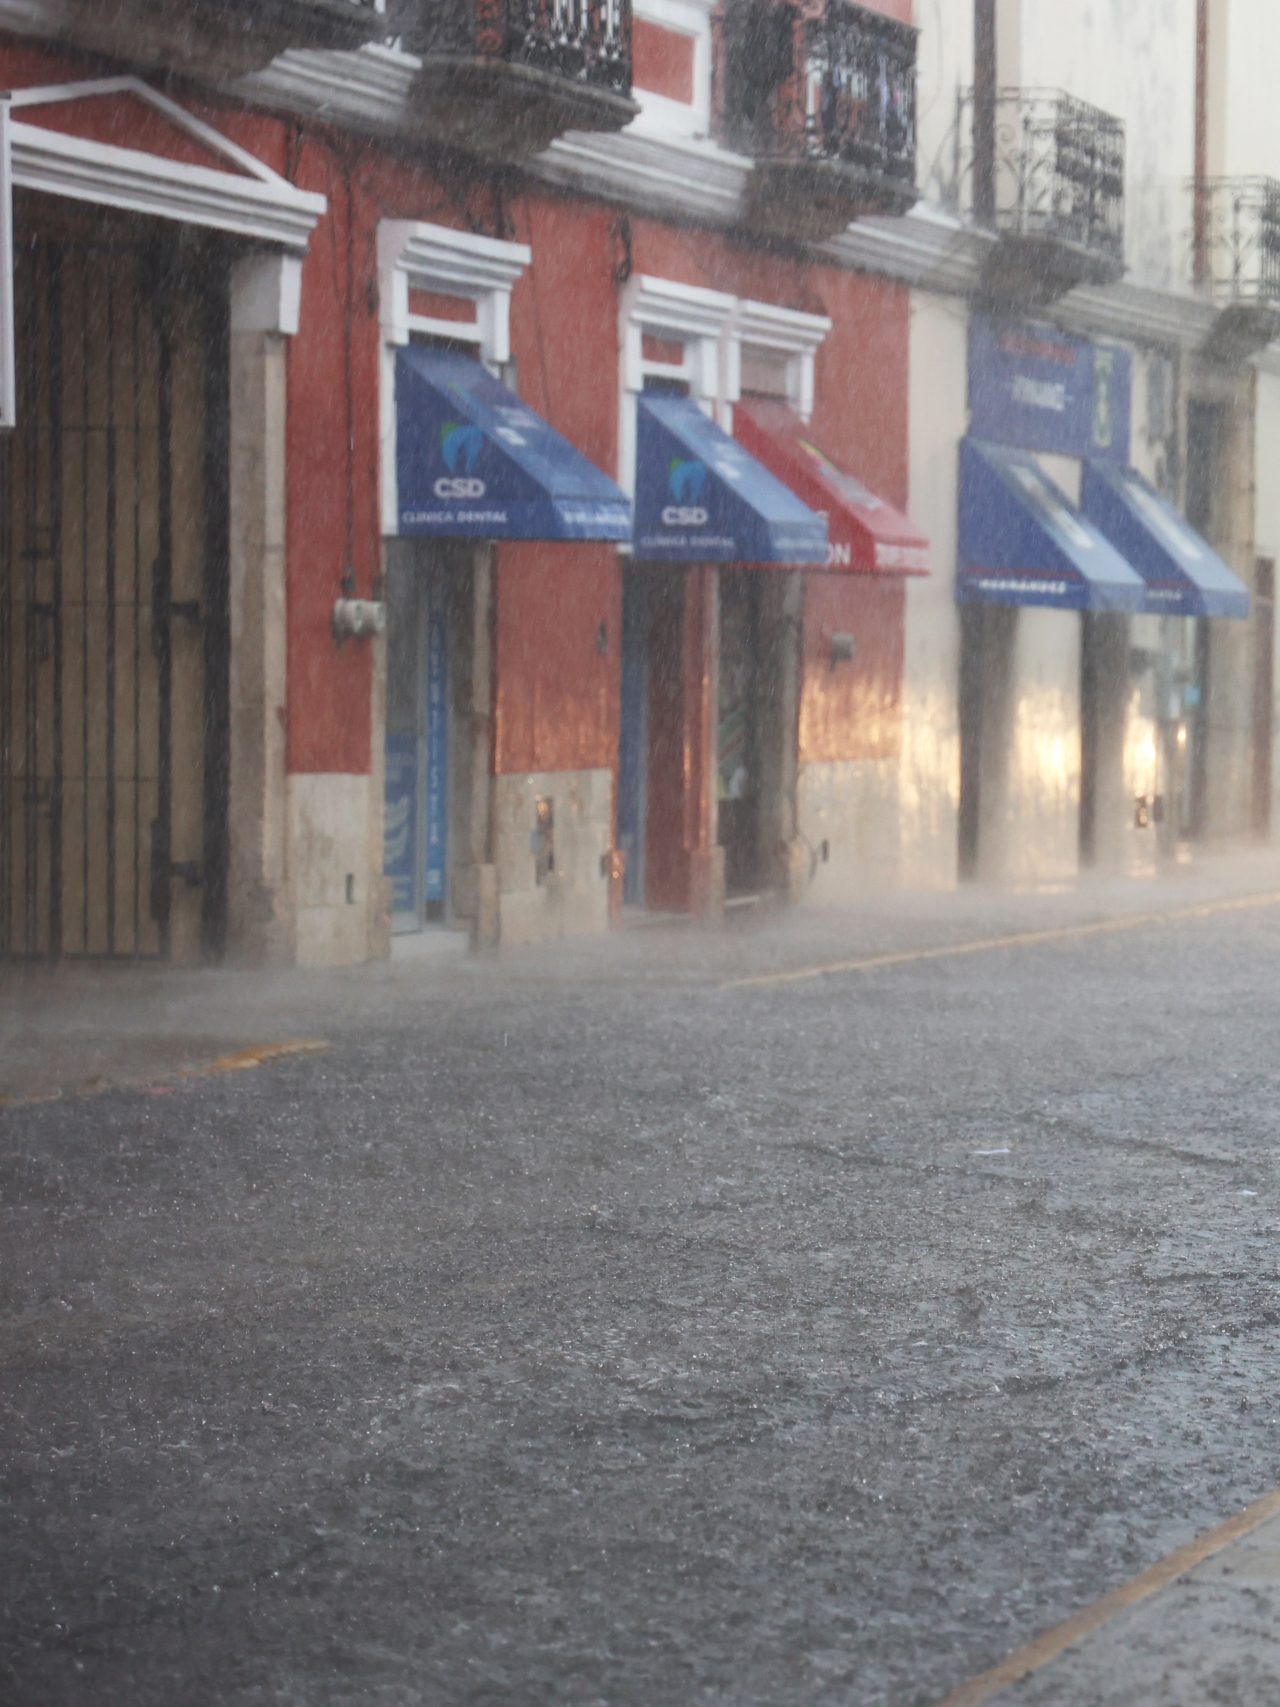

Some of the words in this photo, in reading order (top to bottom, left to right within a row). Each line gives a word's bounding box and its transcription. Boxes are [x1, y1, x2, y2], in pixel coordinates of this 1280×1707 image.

[433, 478, 485, 498] CSD
[457, 510, 507, 523] DENTAL
[661, 506, 708, 526] CSD
